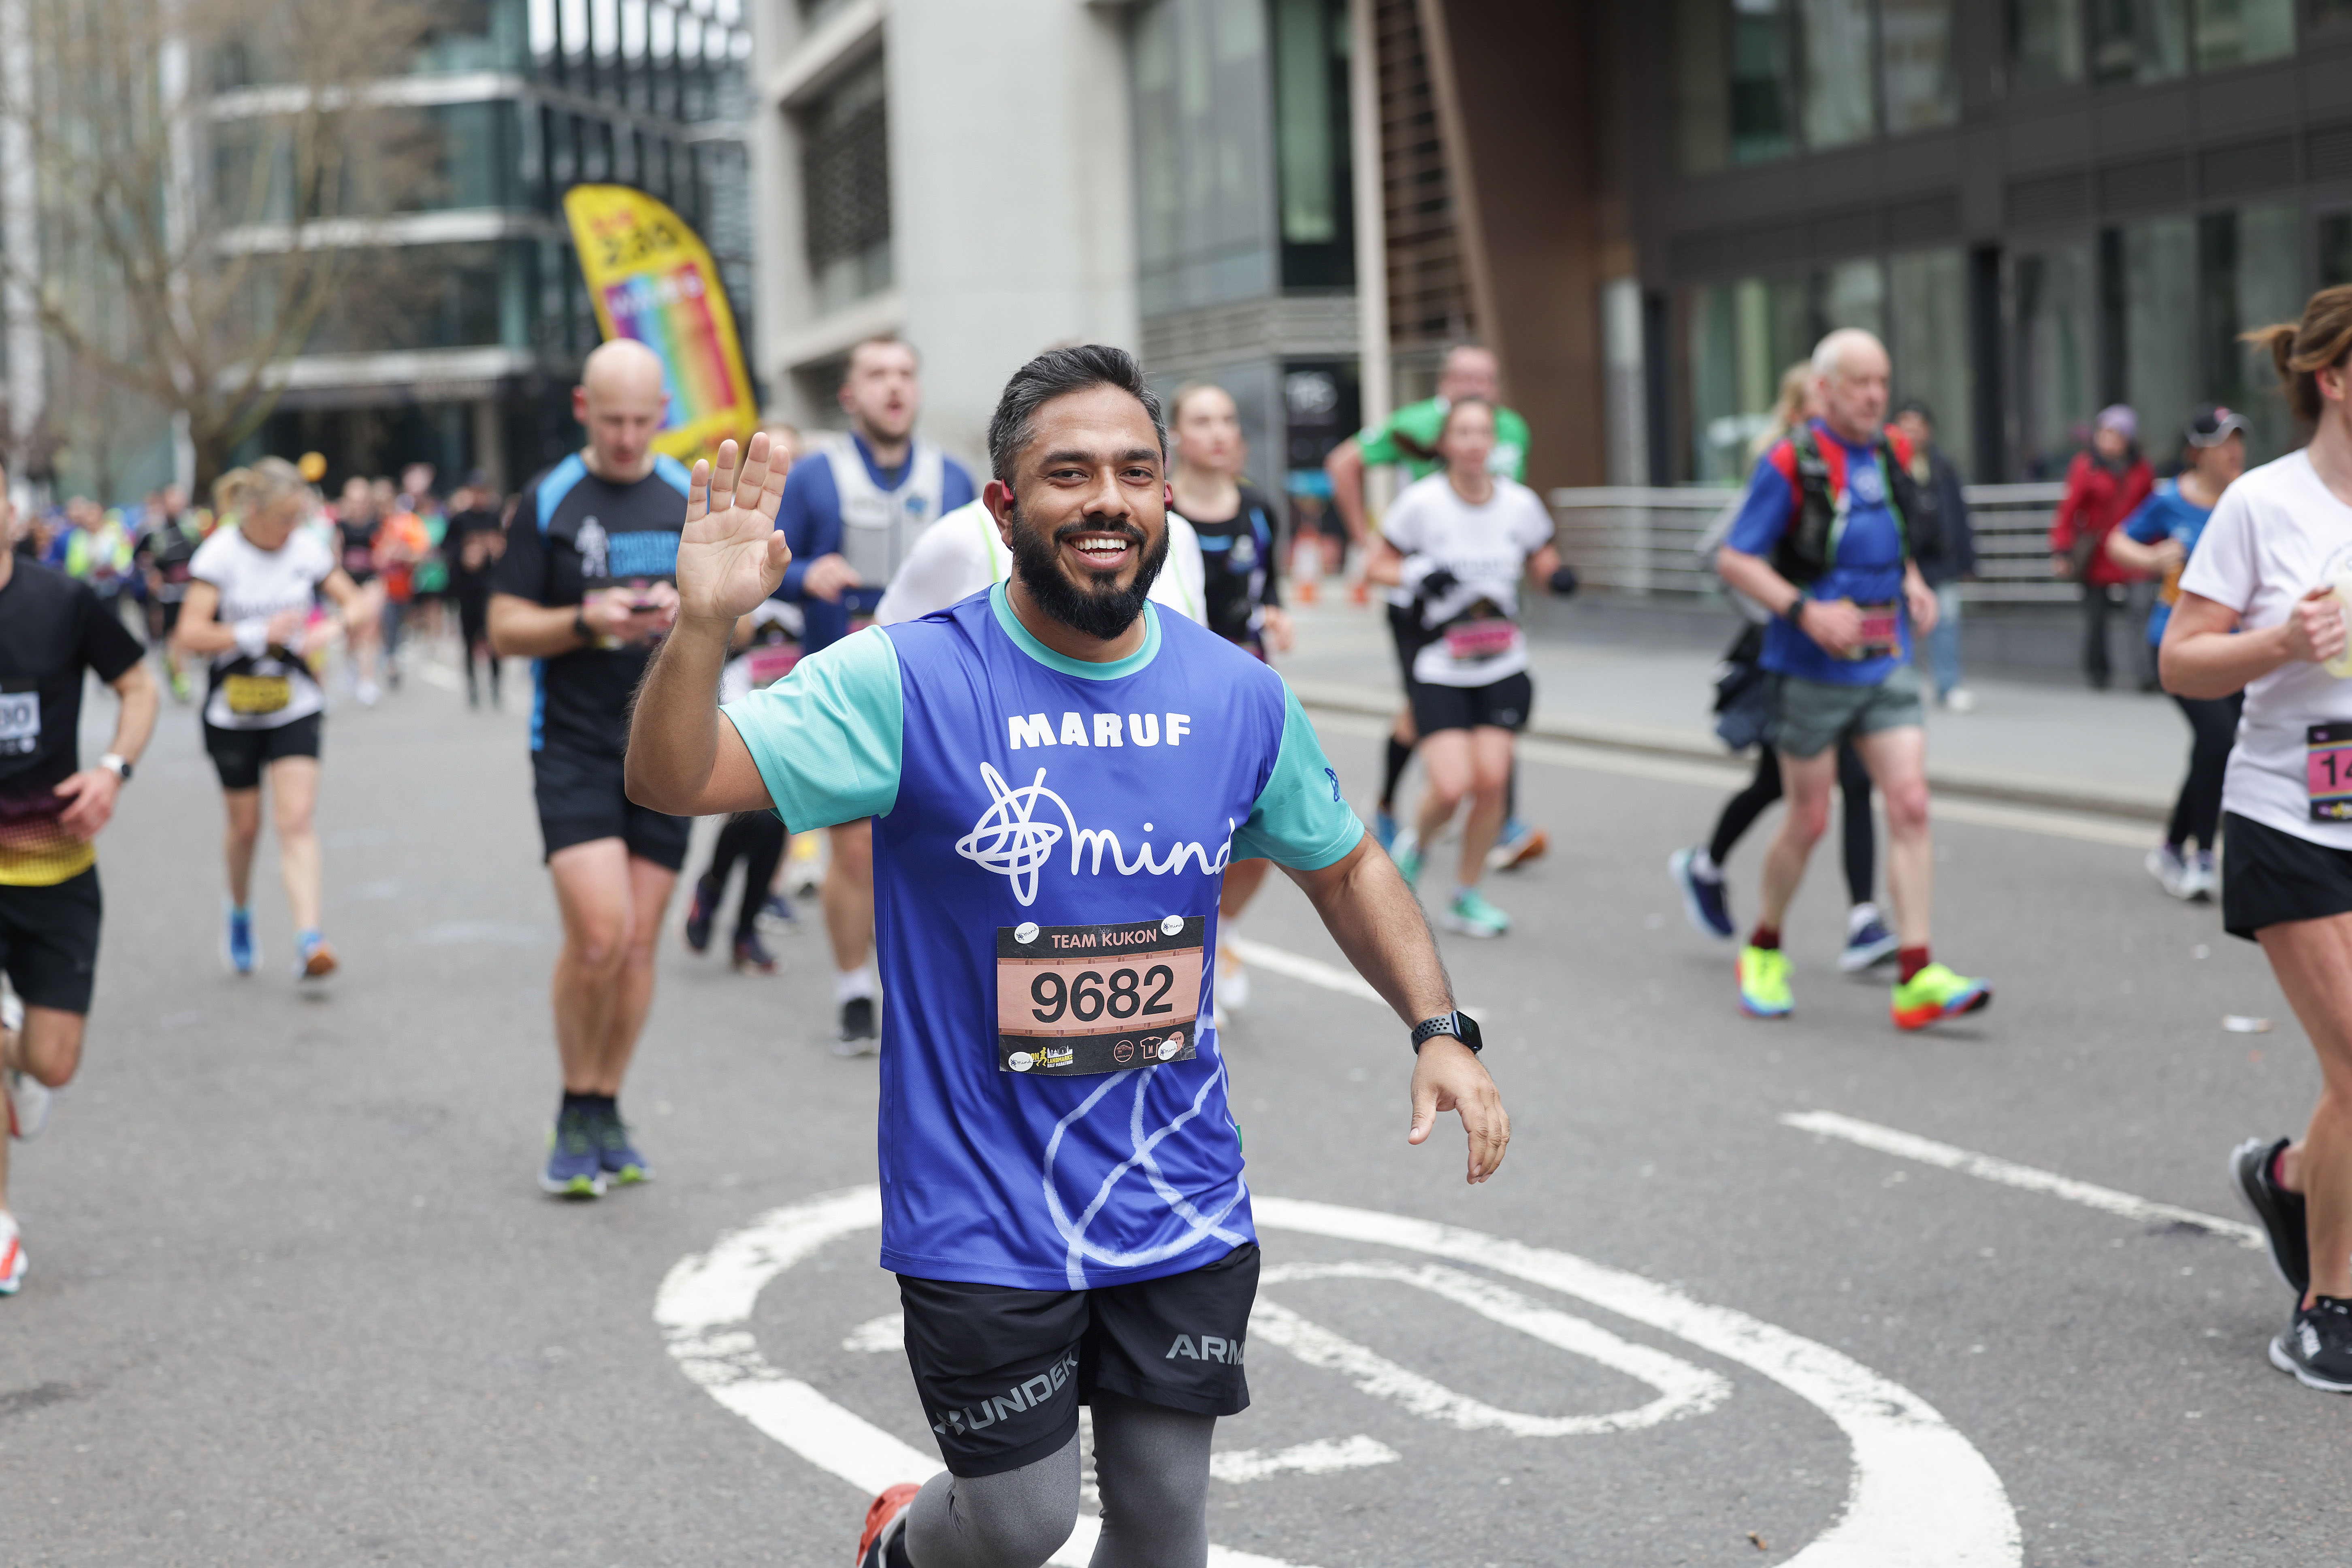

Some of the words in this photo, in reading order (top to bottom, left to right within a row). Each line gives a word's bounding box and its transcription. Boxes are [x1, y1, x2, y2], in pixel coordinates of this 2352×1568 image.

[1008, 712, 1191, 750] MARUF
[1071, 817, 1235, 876] mind
[1051, 933, 1097, 949] TEAM
[1102, 928, 1157, 947] KUKON
[1031, 964, 1174, 1023] 9682
[1047, 1054, 1073, 1064] LANDMARKS
[1055, 1059, 1073, 1067] MARATHON
[1148, 1045, 1153, 1054] M
[962, 1350, 1078, 1431] UNDER
